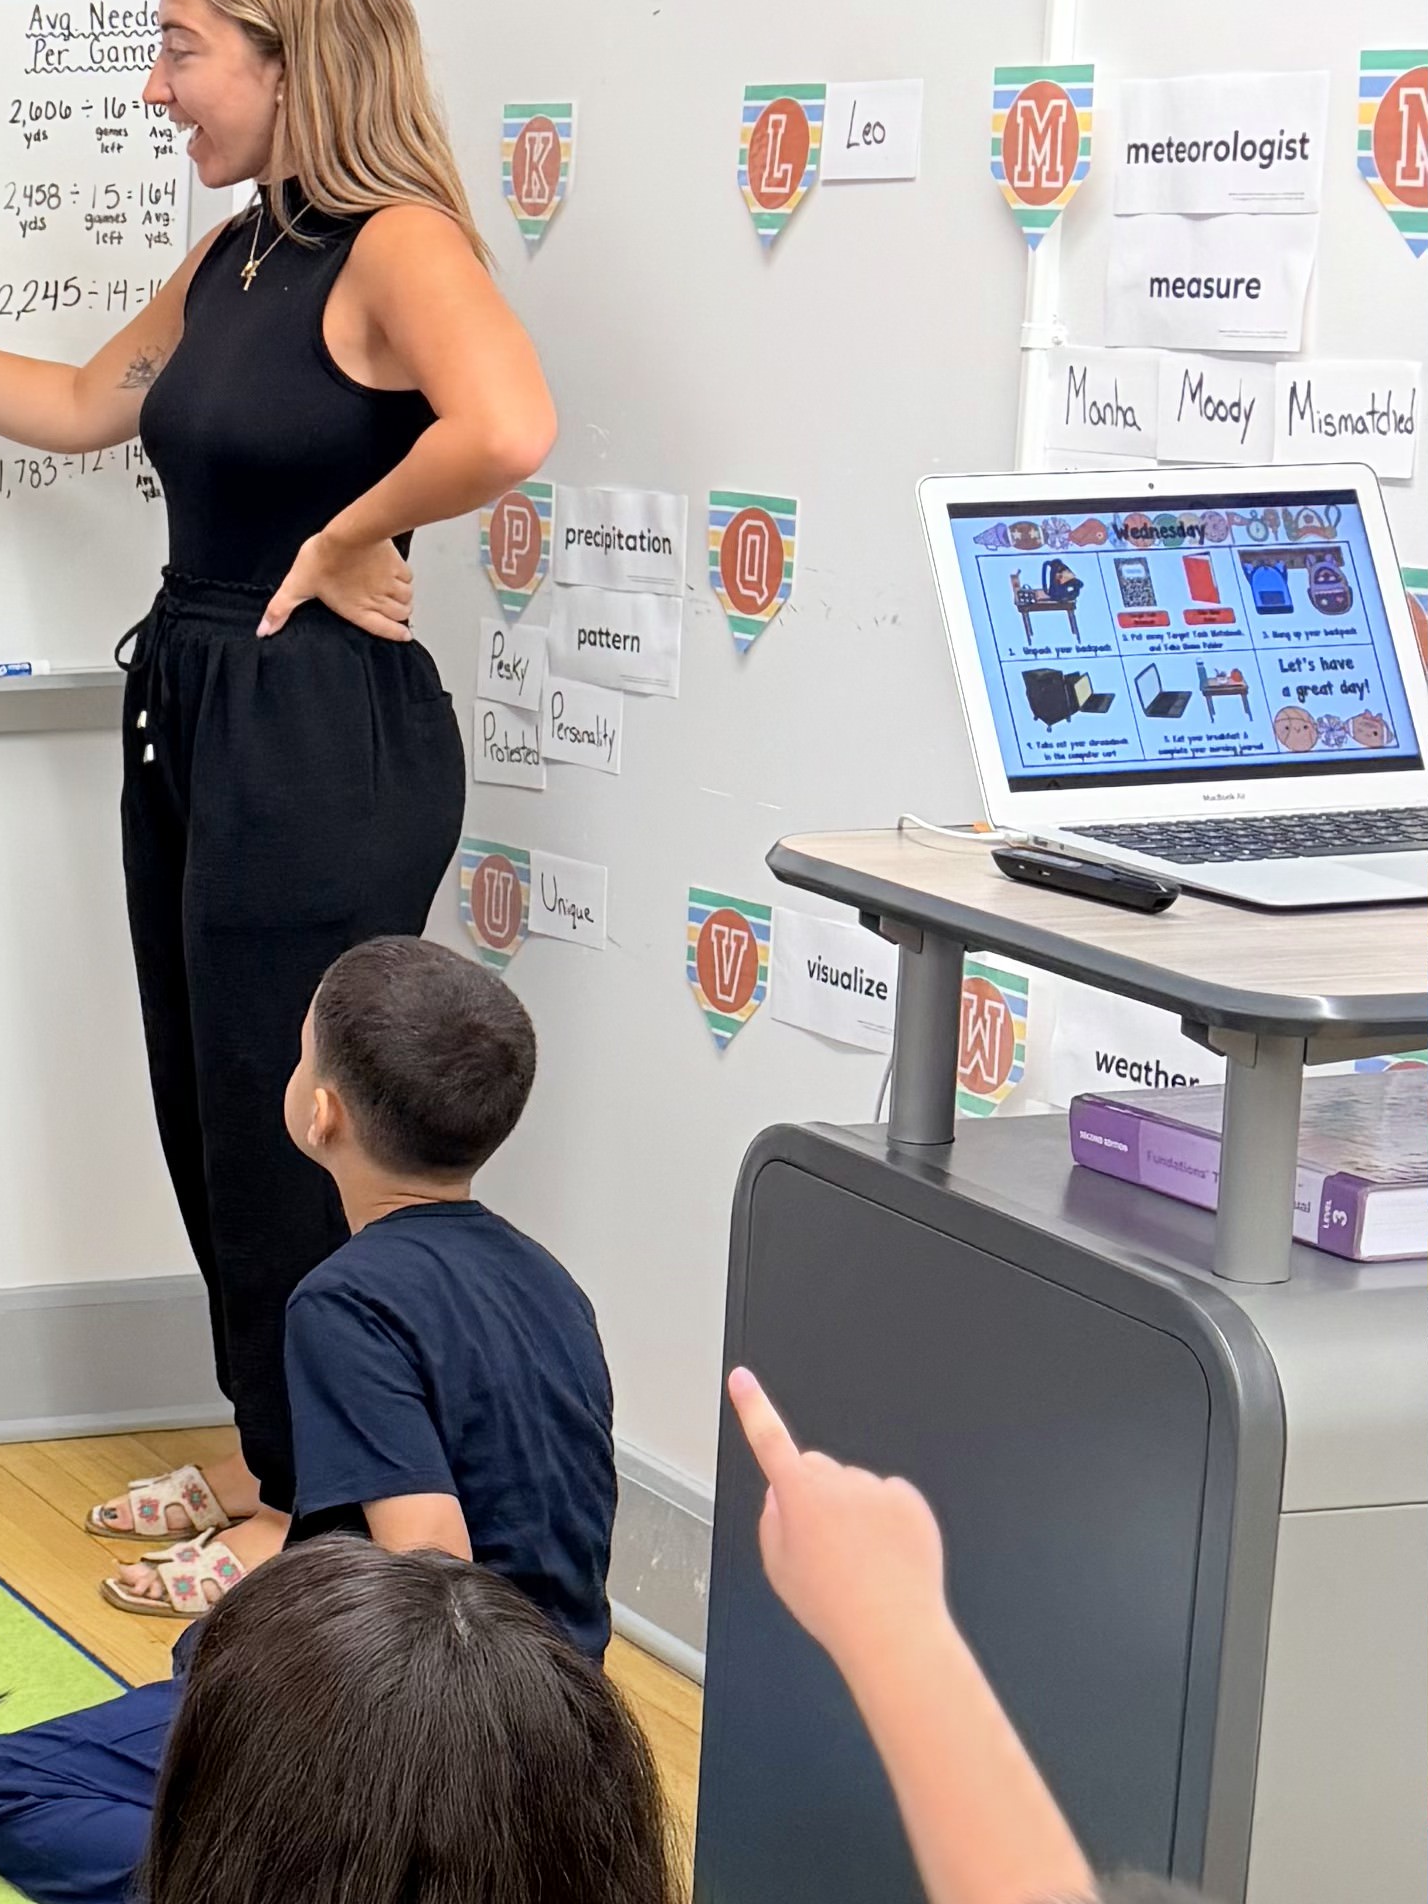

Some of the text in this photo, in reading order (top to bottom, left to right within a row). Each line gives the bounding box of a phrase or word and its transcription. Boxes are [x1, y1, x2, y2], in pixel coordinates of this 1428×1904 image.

[33, 38, 70, 68] Per
[8, 97, 73, 129] 2,606
[846, 100, 886, 150] Leo
[1126, 128, 1312, 170] meteorologist
[3, 181, 62, 216] 2,458
[1147, 270, 1263, 302] measure
[1177, 367, 1256, 446] Moody
[564, 524, 673, 558] precipitation
[1112, 518, 1207, 546] Wednesday
[576, 624, 641, 654] pattern
[1279, 656, 1355, 674] Let's have
[1296, 678, 1371, 704] great day!
[481, 710, 541, 767] Protested
[550, 690, 617, 764] Personality
[540, 871, 596, 929] Unique
[806, 954, 889, 1002] visualize
